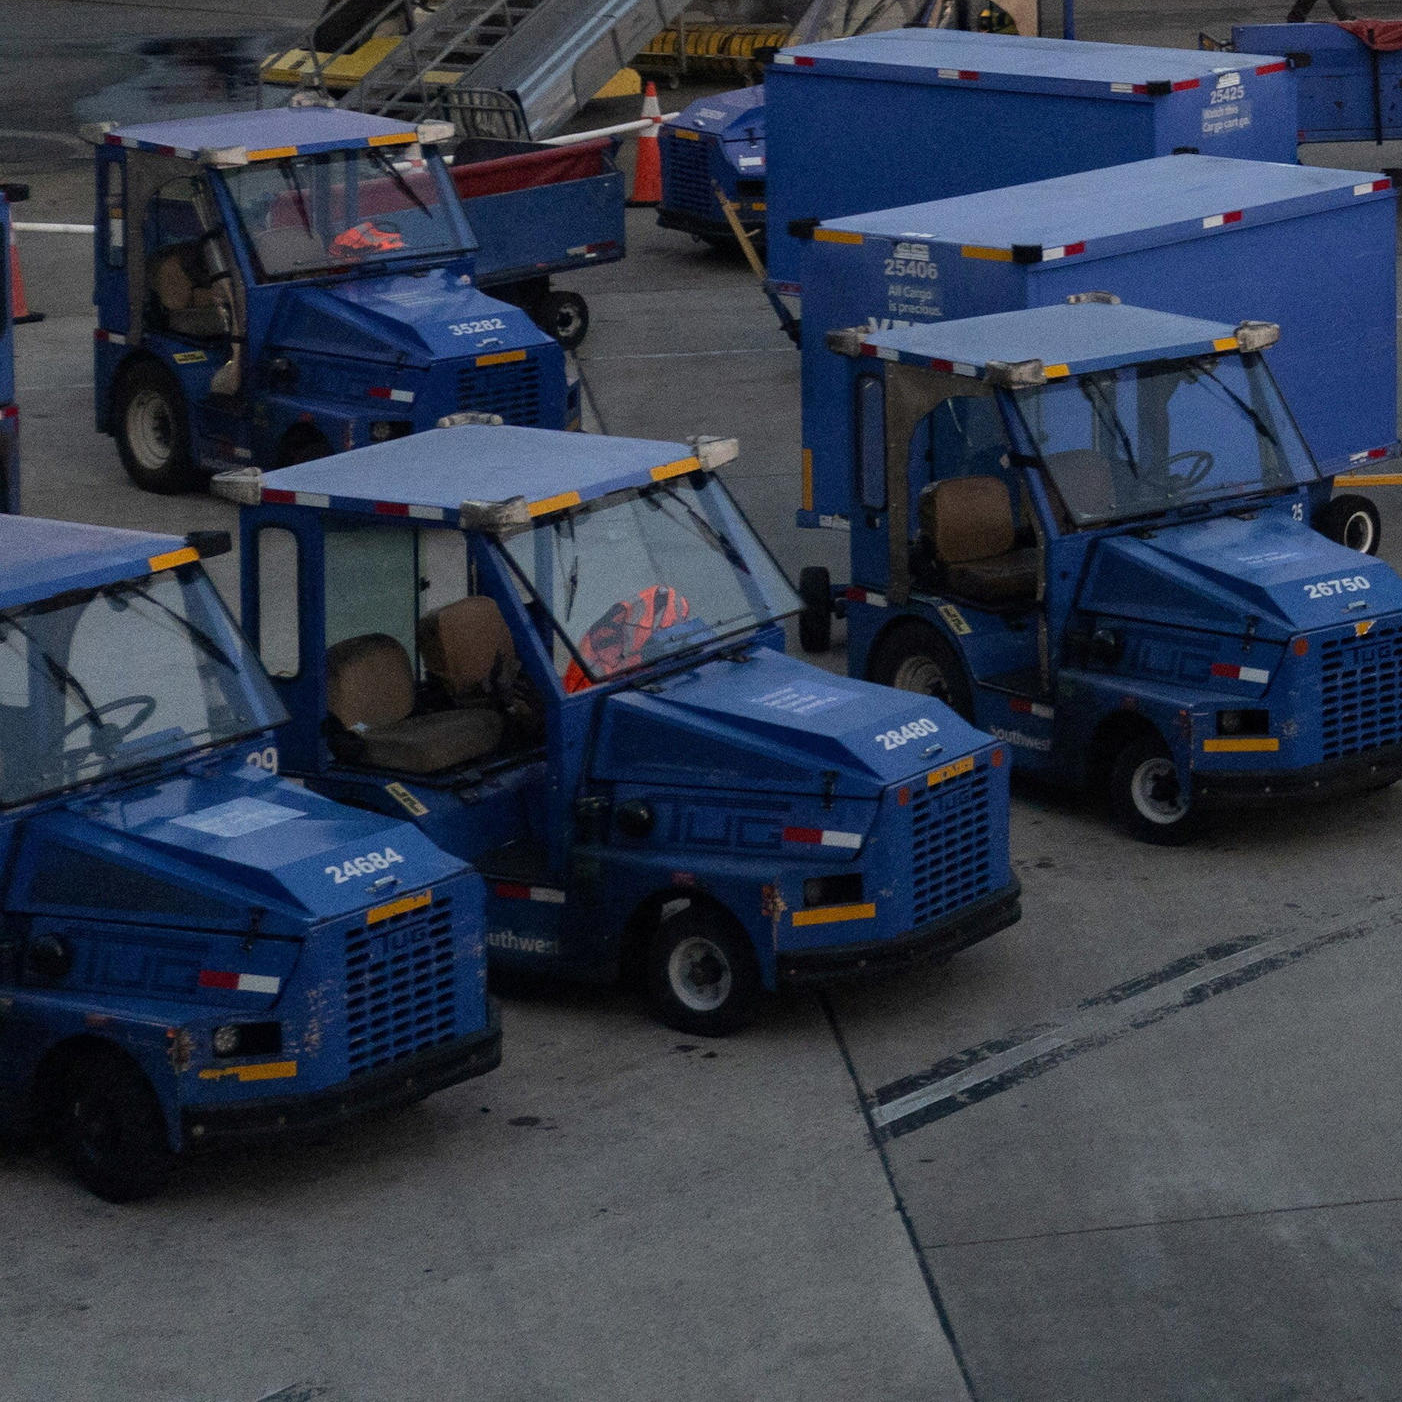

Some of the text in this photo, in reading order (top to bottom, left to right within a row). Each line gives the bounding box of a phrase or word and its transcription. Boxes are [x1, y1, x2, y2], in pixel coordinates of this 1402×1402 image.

[1210, 85, 1245, 105] 25425
[884, 258, 939, 280] 25406
[449, 318, 507, 337] 35282
[1291, 502, 1304, 522] 25
[1303, 575, 1371, 600] 26750
[874, 716, 939, 751] 28480
[324, 846, 405, 885] 24684
